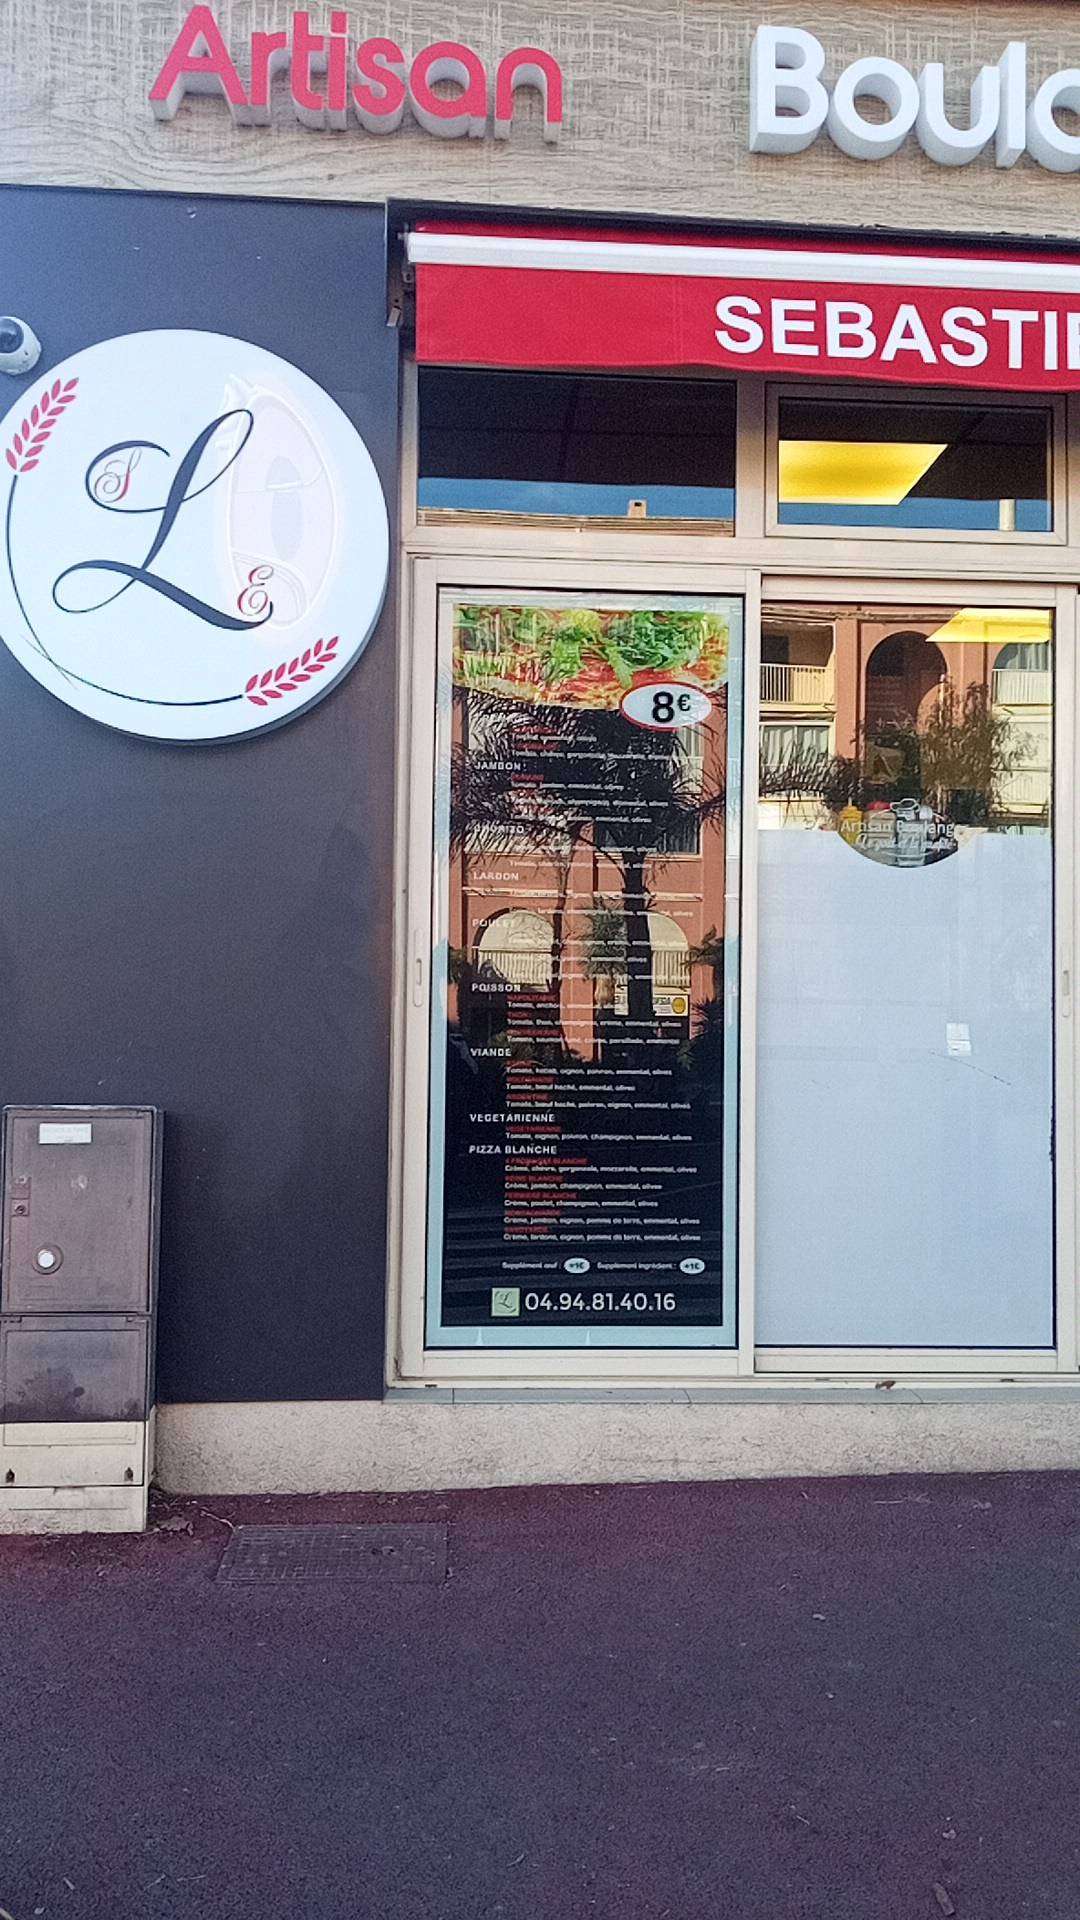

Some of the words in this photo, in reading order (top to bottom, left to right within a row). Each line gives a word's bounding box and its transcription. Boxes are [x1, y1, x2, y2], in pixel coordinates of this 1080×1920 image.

[149, 4, 563, 133] Artisan
[714, 295, 1080, 371] SEBASTI
[471, 983, 521, 993] POISSON
[470, 1048, 512, 1057] VIANDE
[469, 1146, 501, 1154] PIZZA
[505, 1146, 557, 1154] BLANCHE
[525, 1293, 676, 1311] 04.94.81.40.16
